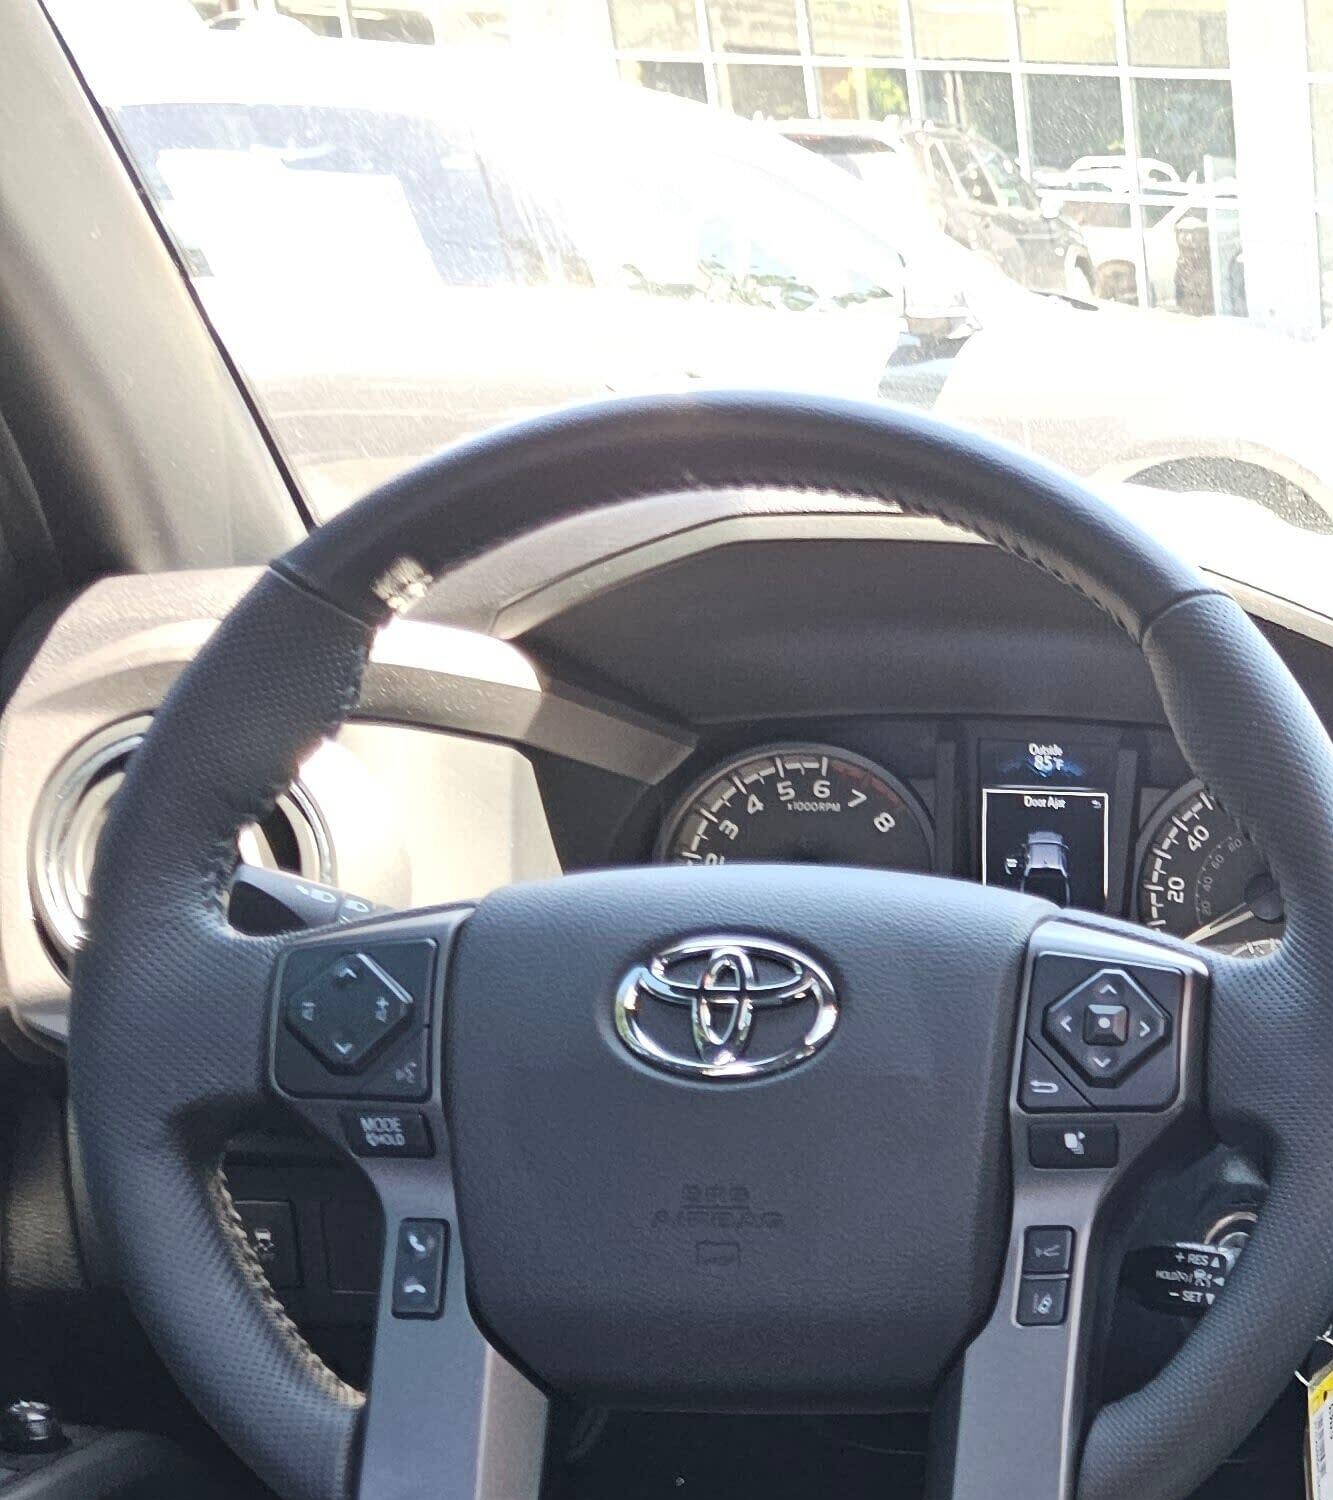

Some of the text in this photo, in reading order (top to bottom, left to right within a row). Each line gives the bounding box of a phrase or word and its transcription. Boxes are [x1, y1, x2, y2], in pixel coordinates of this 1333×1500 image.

[776, 780, 796, 801] 5
[812, 779, 831, 799] 6
[846, 788, 868, 808] 7
[747, 793, 764, 814] 4
[1023, 795, 1046, 808] Door
[718, 819, 739, 840] 3
[873, 811, 896, 832] 8
[1187, 825, 1210, 852] 40
[1167, 876, 1186, 903] 20
[359, 1117, 403, 1132] MODE
[1187, 1253, 1209, 1266] RES
[1182, 1290, 1204, 1303] SET
